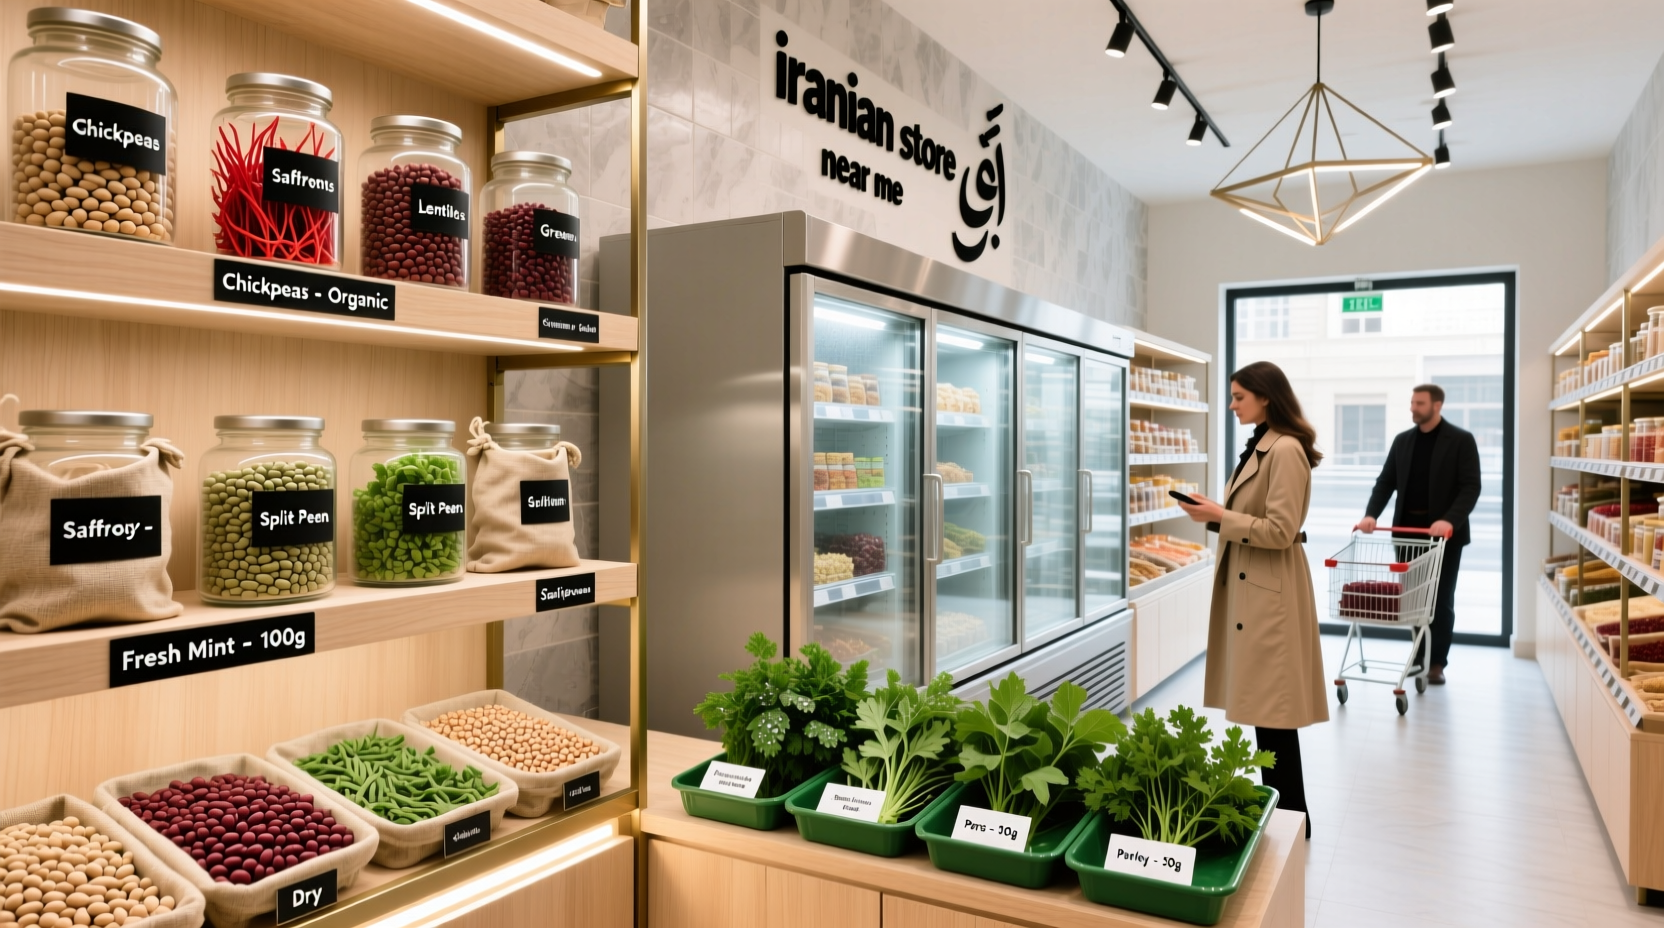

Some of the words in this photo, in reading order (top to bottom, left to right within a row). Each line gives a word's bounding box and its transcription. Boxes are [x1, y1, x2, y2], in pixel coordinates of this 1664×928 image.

[775, 29, 895, 152] iranian
[899, 123, 957, 181] store
[72, 117, 160, 151] Chickpeas
[821, 147, 871, 193] near
[873, 171, 904, 206] me
[222, 271, 308, 301] Chickpeas
[327, 286, 389, 311] Organic
[259, 508, 294, 531] Split
[121, 643, 181, 671] Fresh
[188, 637, 236, 661] Mint
[260, 627, 306, 649] 100g
[292, 886, 322, 908] Dry
